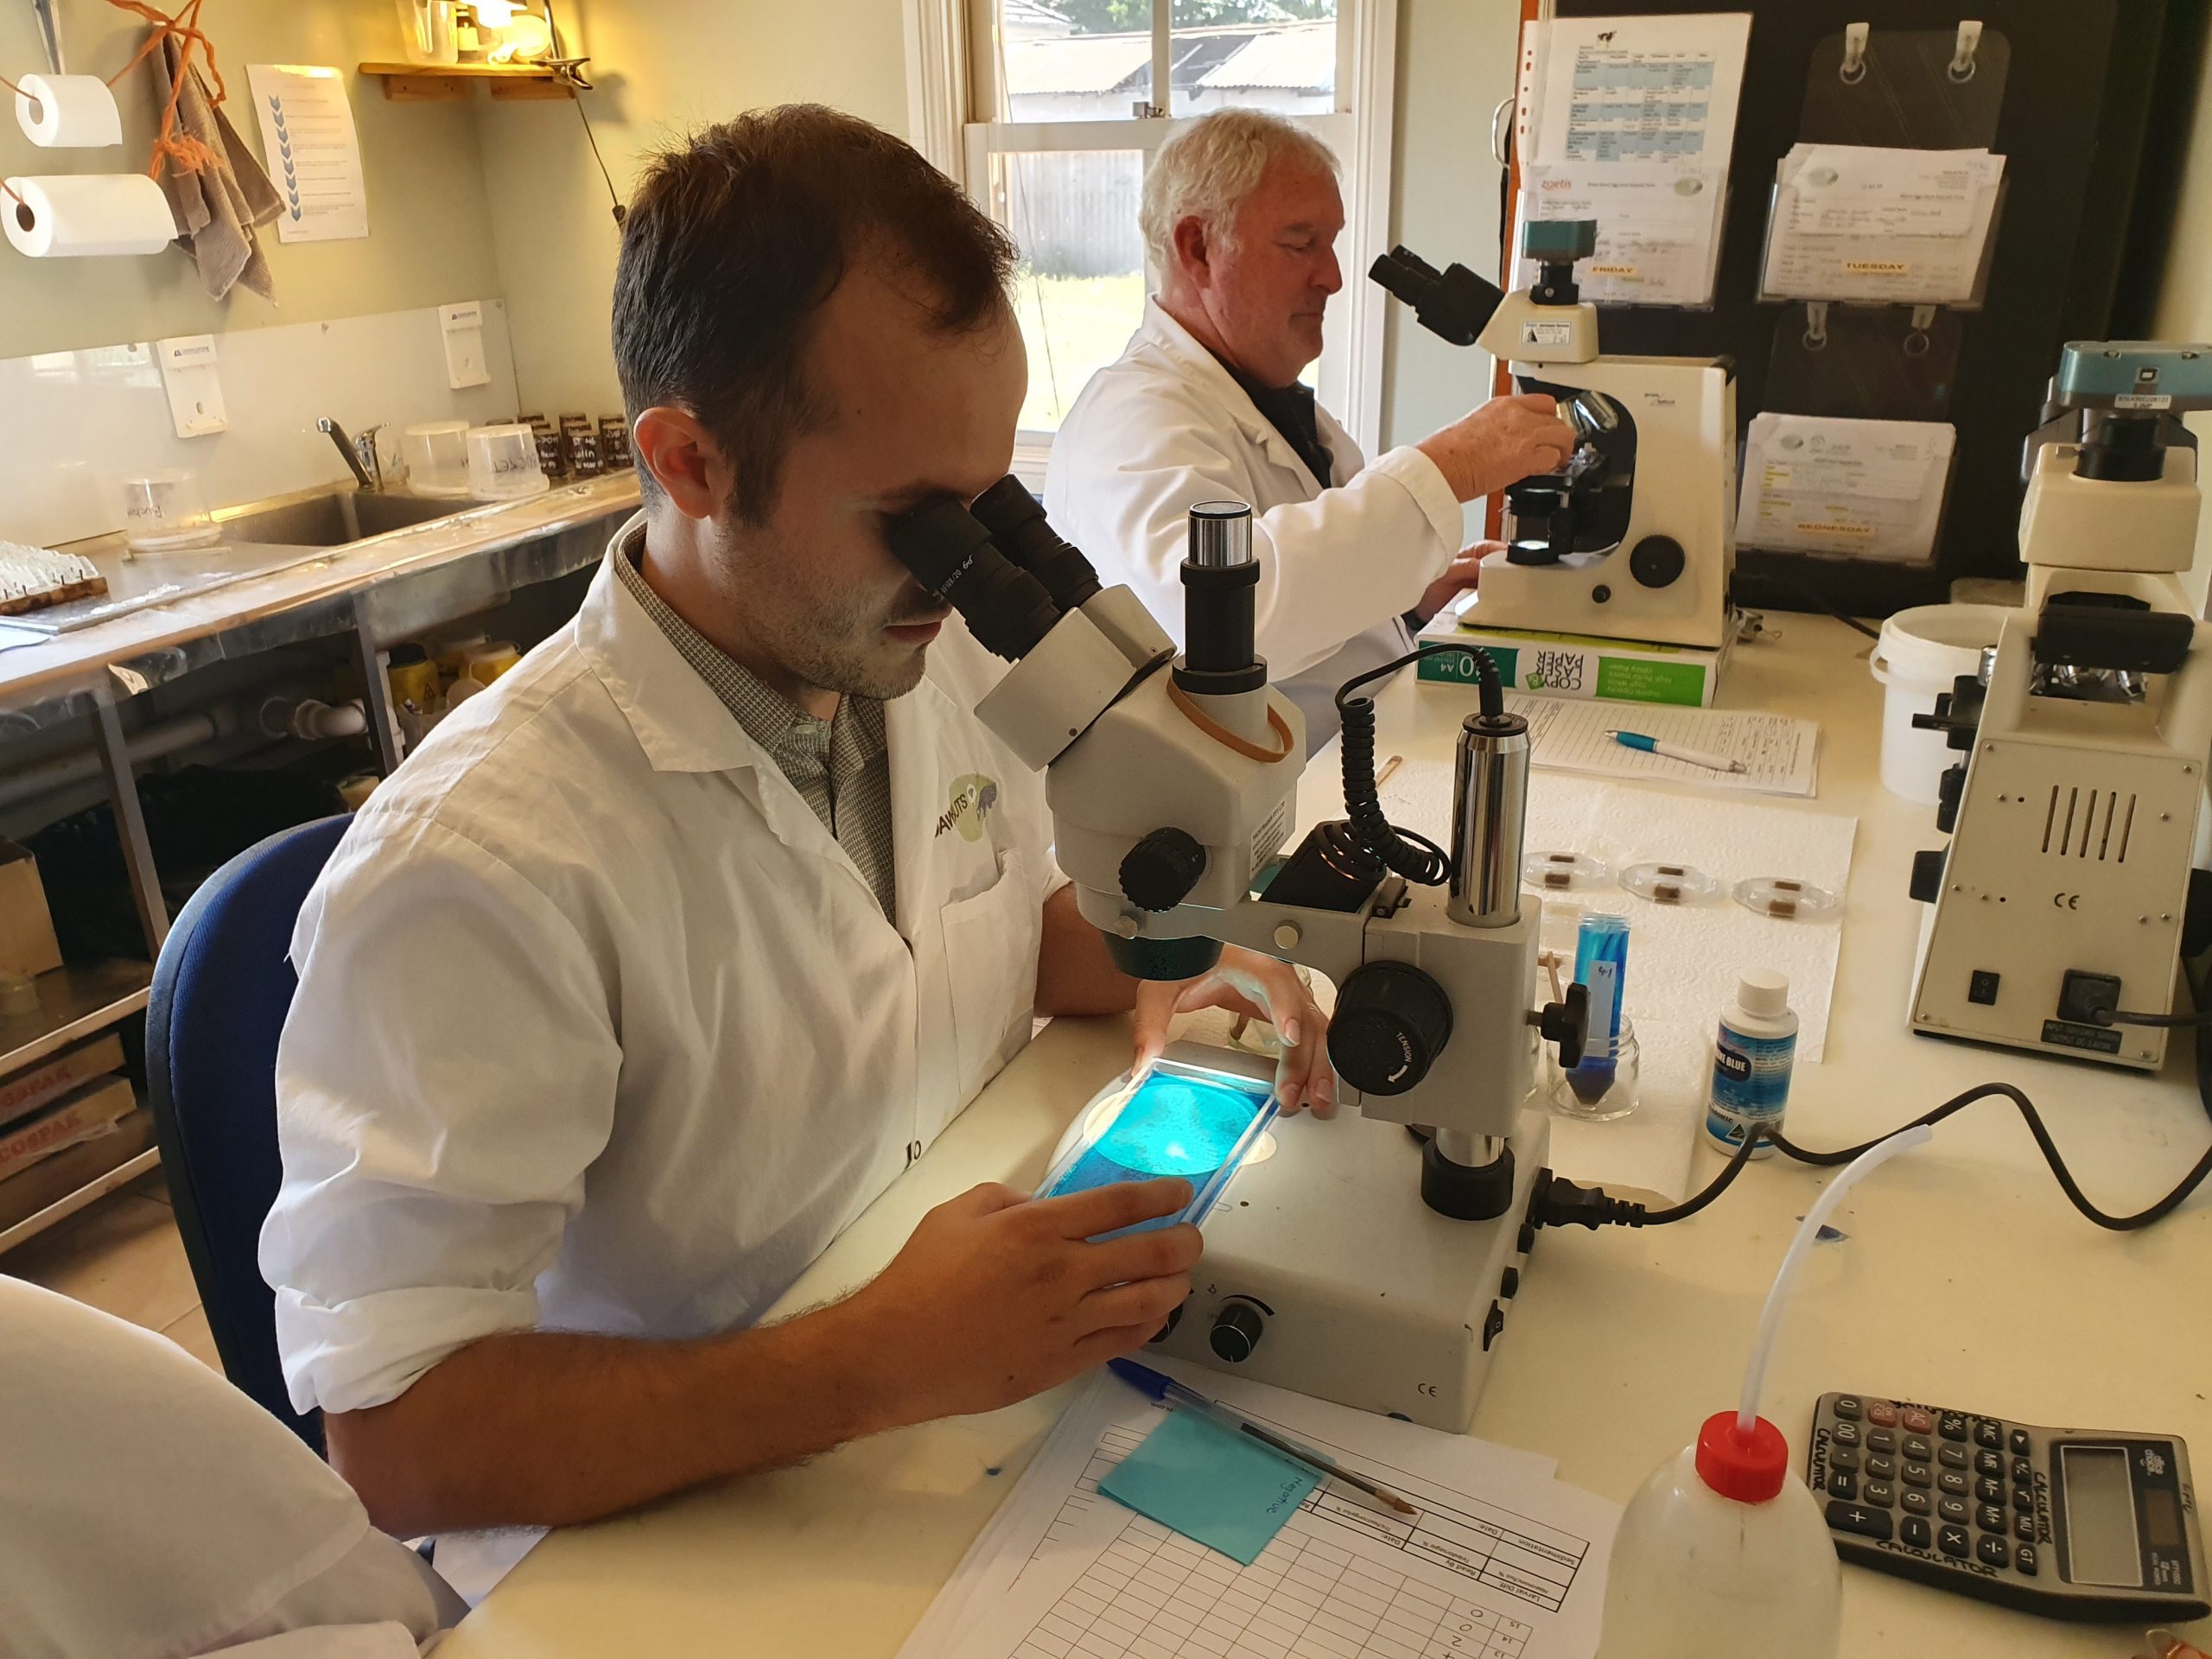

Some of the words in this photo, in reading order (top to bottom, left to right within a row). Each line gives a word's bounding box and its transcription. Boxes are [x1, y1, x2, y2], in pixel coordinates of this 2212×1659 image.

[1847, 262, 1904, 270] TUESDAY
[1797, 523, 1871, 534] WEDNESDAY
[1537, 651, 1584, 668] PAPER
[1440, 663, 1454, 672] A4
[1536, 663, 1583, 679] LASER
[1542, 677, 1582, 690] COPY
[1395, 1031, 1413, 1063] TENSION
[1726, 1056, 1746, 1072] BLUE
[1910, 1411, 1927, 1426] AC
[1838, 1424, 1855, 1439] 00
[1983, 1424, 1996, 1441] MC
[1908, 1440, 1926, 1450] 4
[1944, 1449, 1963, 1459] 7
[1983, 1452, 1997, 1468] MR
[1871, 1458, 1889, 1468] 2
[1907, 1466, 1926, 1476] 5
[1944, 1474, 1963, 1484] 8
[1266, 1476, 1303, 1513] Negative
[1870, 1485, 1888, 1495] 3
[1907, 1493, 1925, 1503] 6
[1944, 1502, 1963, 1511] 9
[1478, 1522, 1498, 1535] Date:
[1382, 1533, 1402, 1546] Date:
[1518, 1538, 1576, 1566] Sedimentation
[2020, 1548, 2033, 1564] GT
[1444, 1559, 1454, 1567] By
[1456, 1564, 1477, 1577] Read
[1516, 1587, 1541, 1602] Larval
